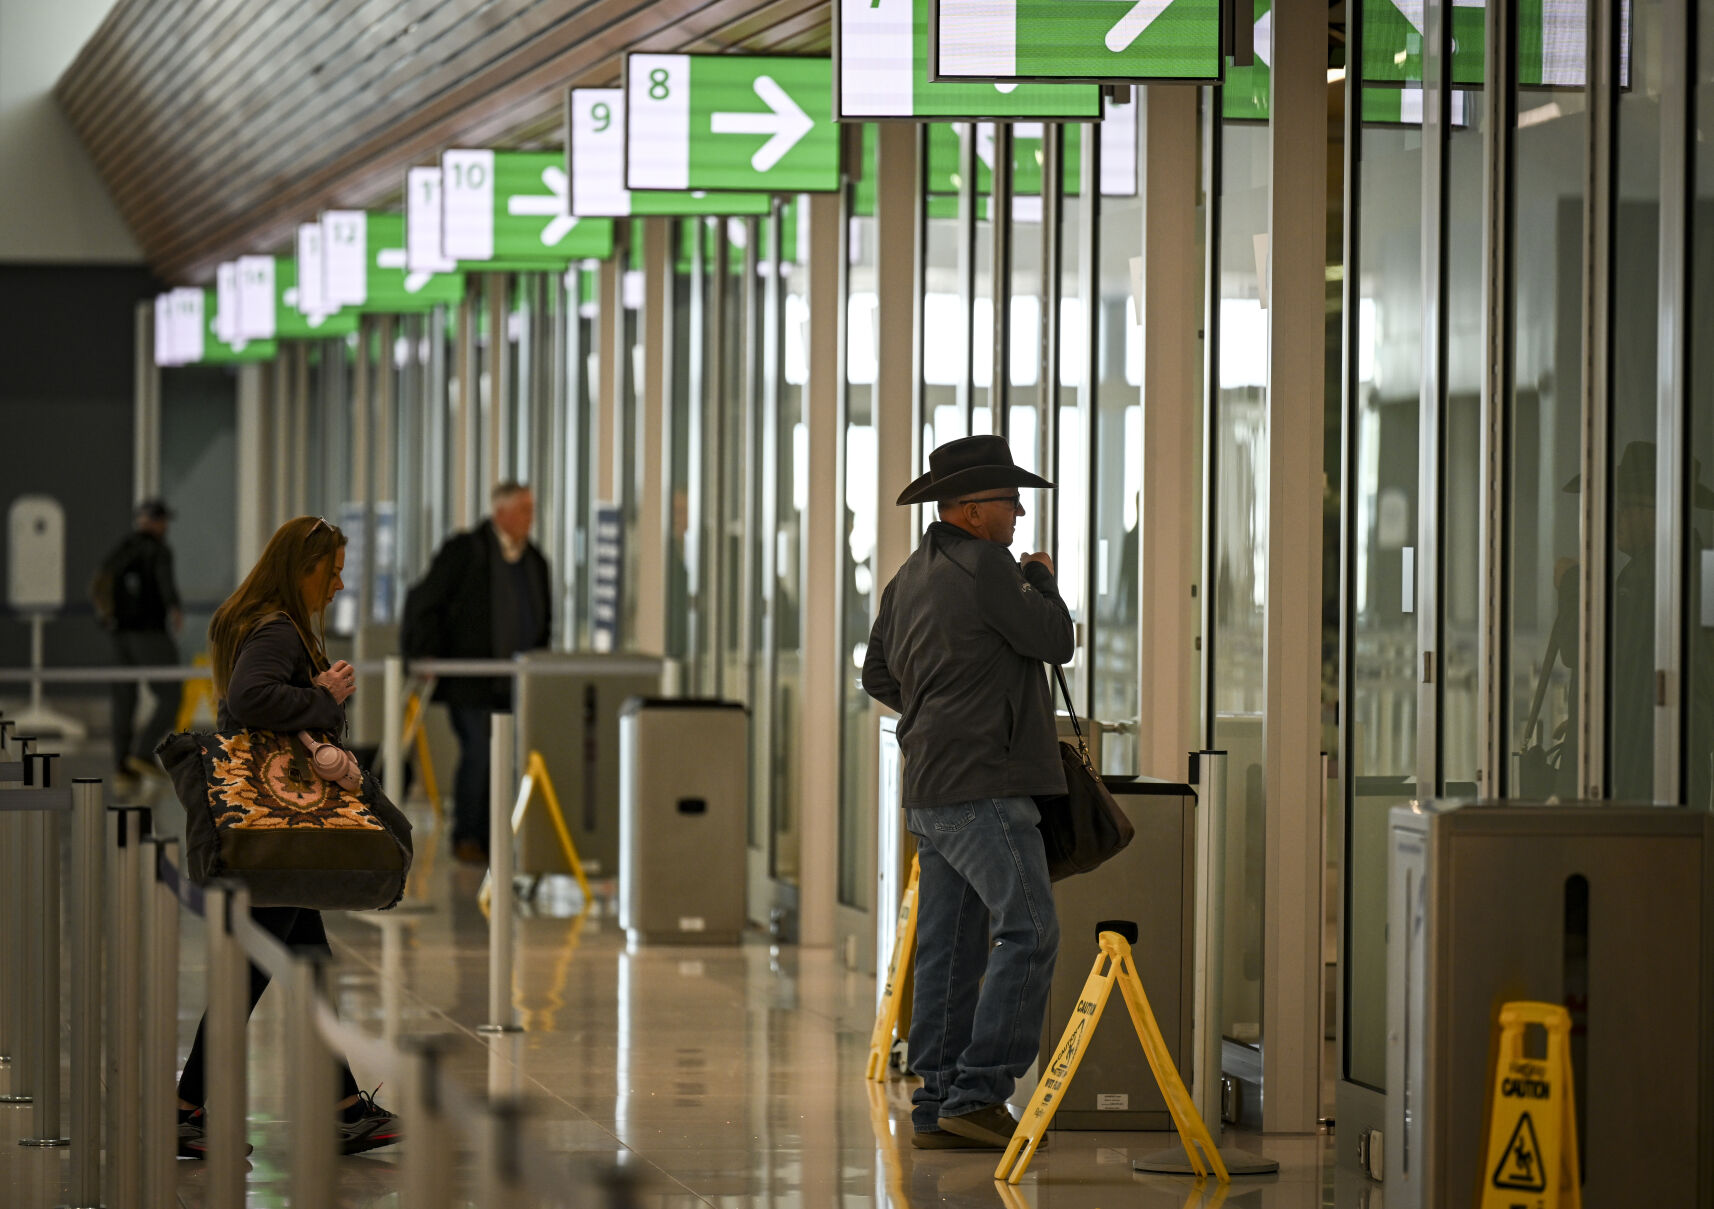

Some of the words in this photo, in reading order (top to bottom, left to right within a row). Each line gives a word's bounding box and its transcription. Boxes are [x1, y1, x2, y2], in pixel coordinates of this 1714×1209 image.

[648, 68, 671, 100] 8
[590, 102, 612, 132] 9
[452, 161, 487, 190] 10
